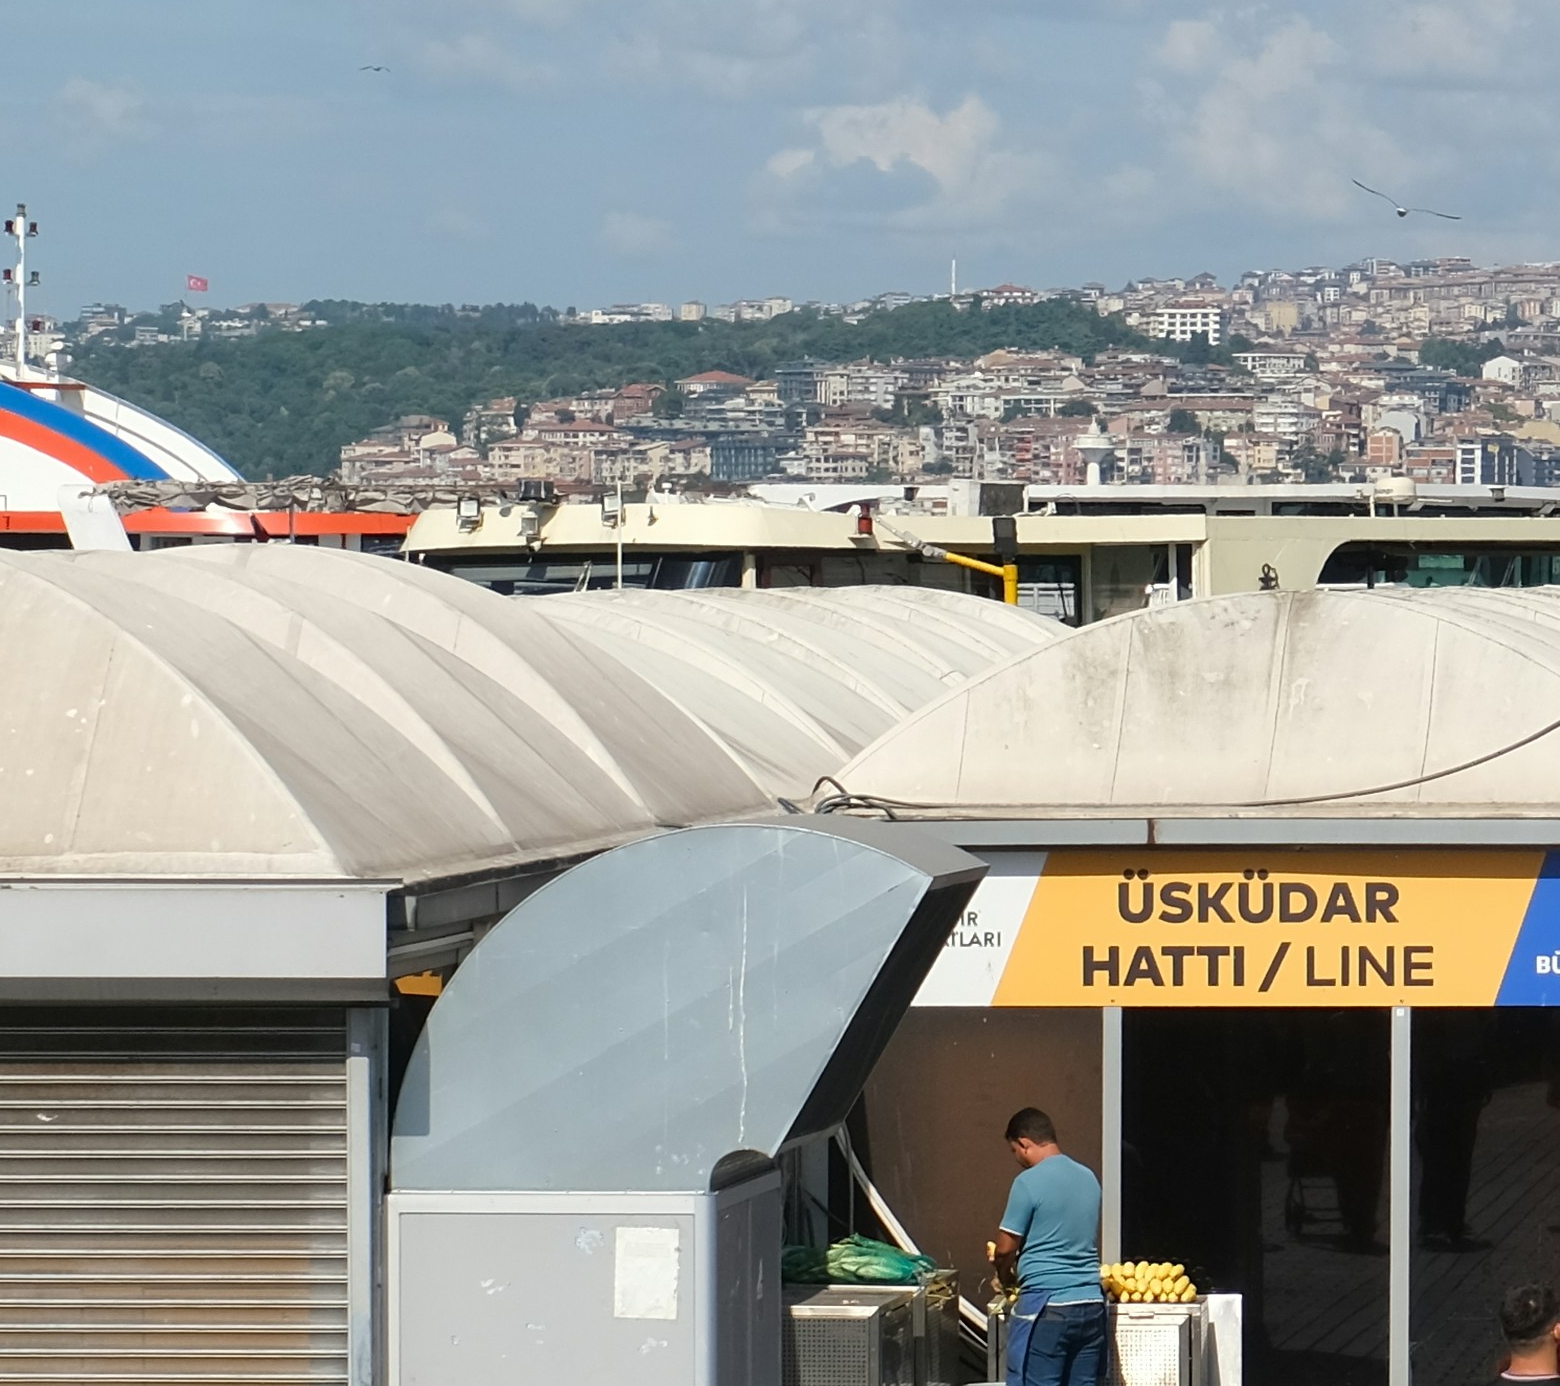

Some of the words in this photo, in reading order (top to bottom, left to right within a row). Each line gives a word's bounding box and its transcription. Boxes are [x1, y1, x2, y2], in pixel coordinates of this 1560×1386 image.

[1117, 868, 1400, 924] ÜSKÜDAR
[1082, 945, 1246, 987] HATTI
[1257, 942, 1292, 993] /
[1305, 945, 1435, 987] LINE
